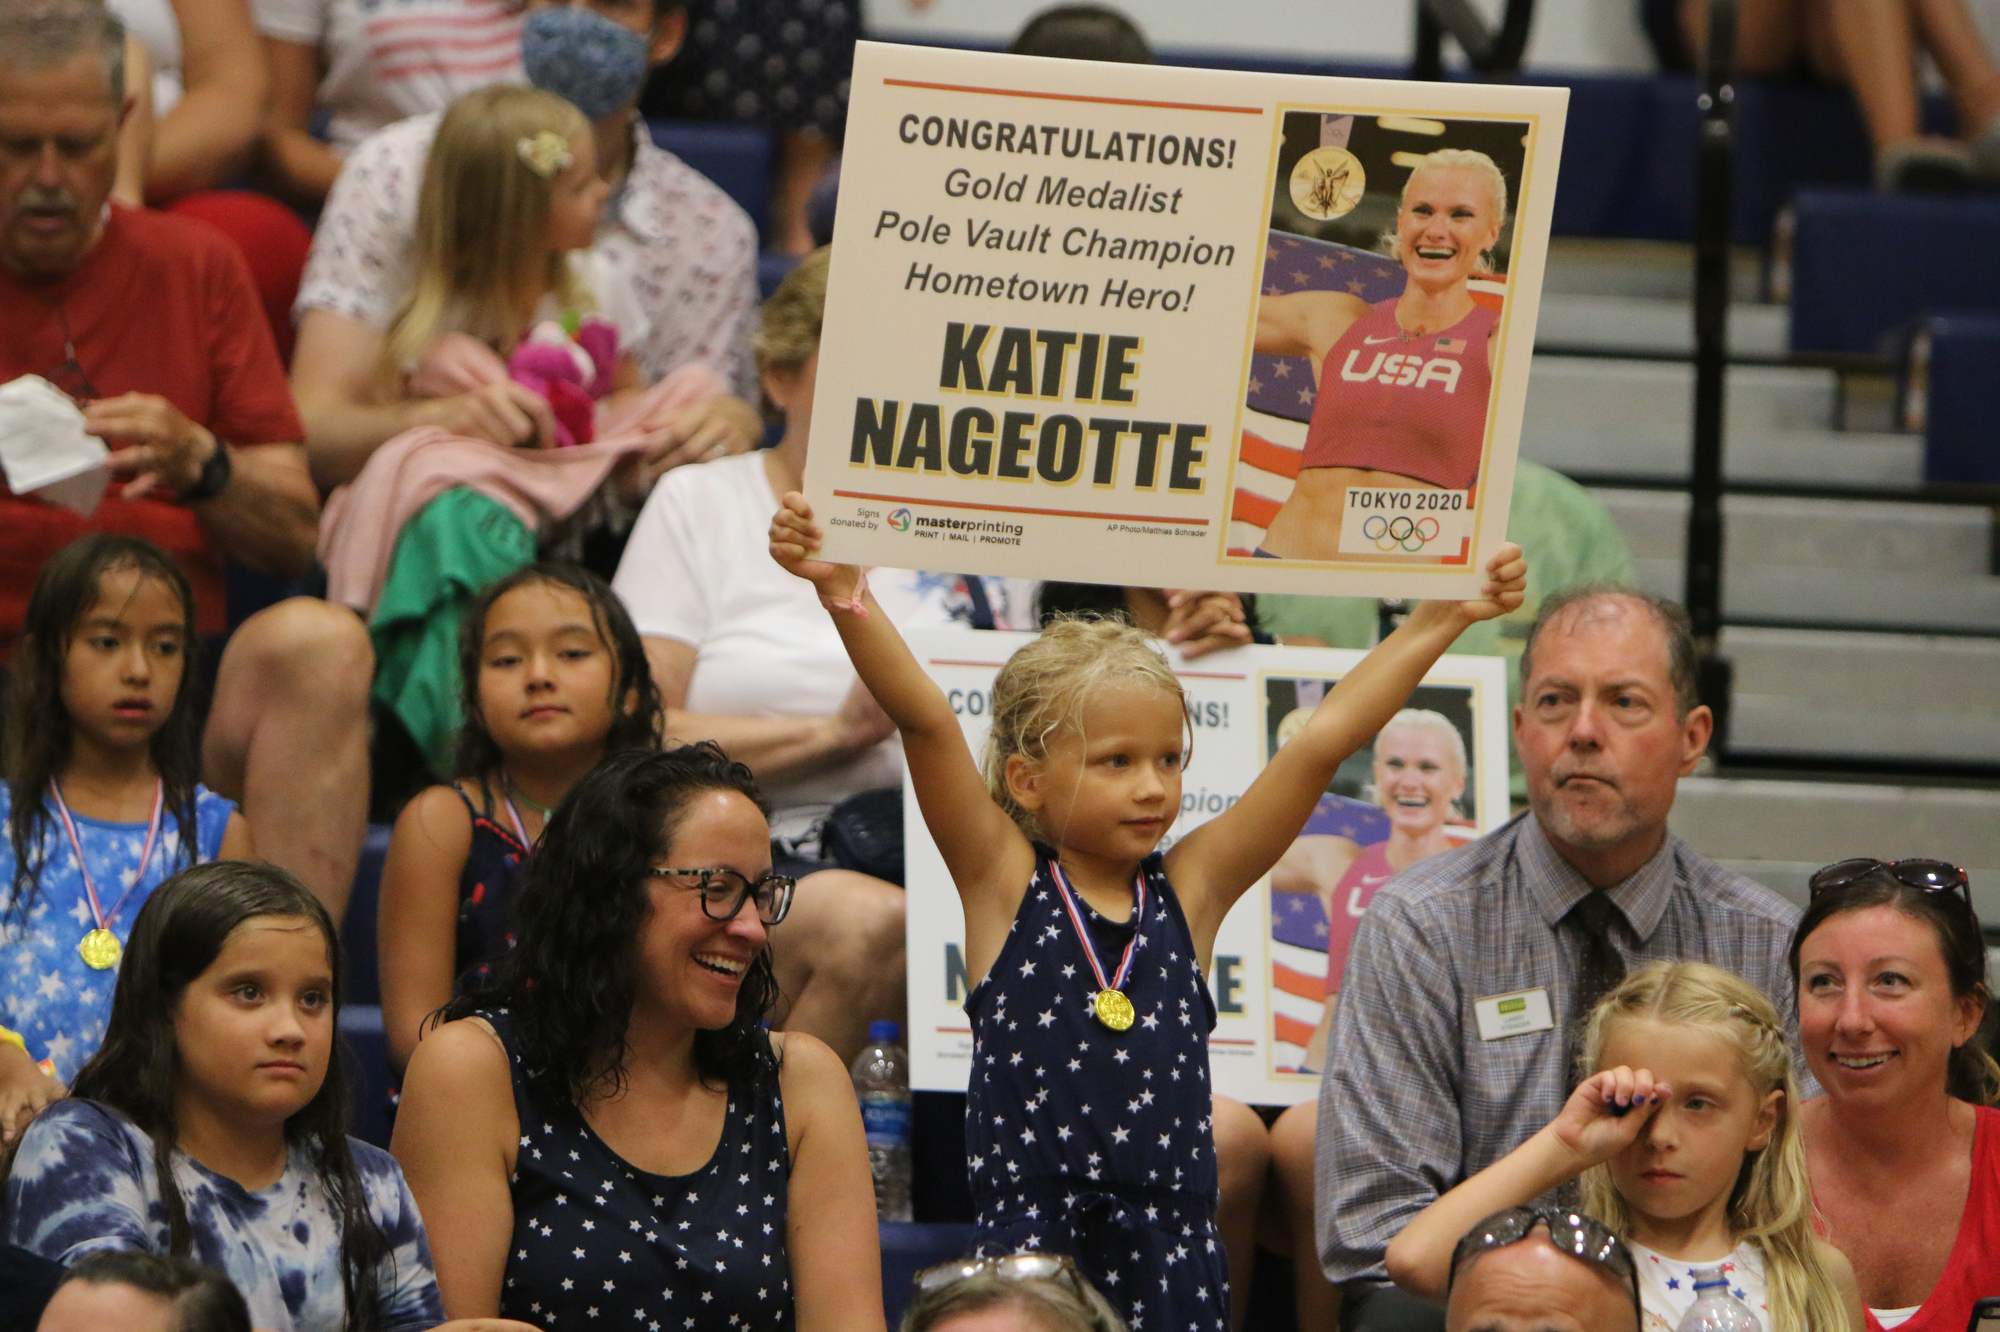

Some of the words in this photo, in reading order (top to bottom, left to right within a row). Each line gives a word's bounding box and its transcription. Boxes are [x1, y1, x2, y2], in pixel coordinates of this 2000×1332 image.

[899, 112, 1237, 169] CONGRATULATIONS!
[944, 167, 1028, 203] Gold
[1035, 175, 1183, 215] Medalist
[874, 209, 951, 245] Pole
[966, 217, 1051, 254] Vault
[1062, 226, 1236, 270] Champion
[904, 261, 1089, 305] Hometown
[1100, 278, 1196, 313] Hero!
[939, 321, 1145, 407] KATIE
[1340, 349, 1462, 394] USA
[849, 396, 1212, 495] NAGEOTTE
[857, 507, 880, 519] Signs
[1349, 490, 1411, 510] TOKYO
[1415, 492, 1462, 511] 2020
[830, 517, 866, 529] donated
[867, 520, 879, 532] by
[914, 530, 939, 539] PRINT
[949, 532, 969, 542] MAIL
[979, 535, 1021, 546] PROMOTE
[915, 515, 1024, 536] masterprinting
